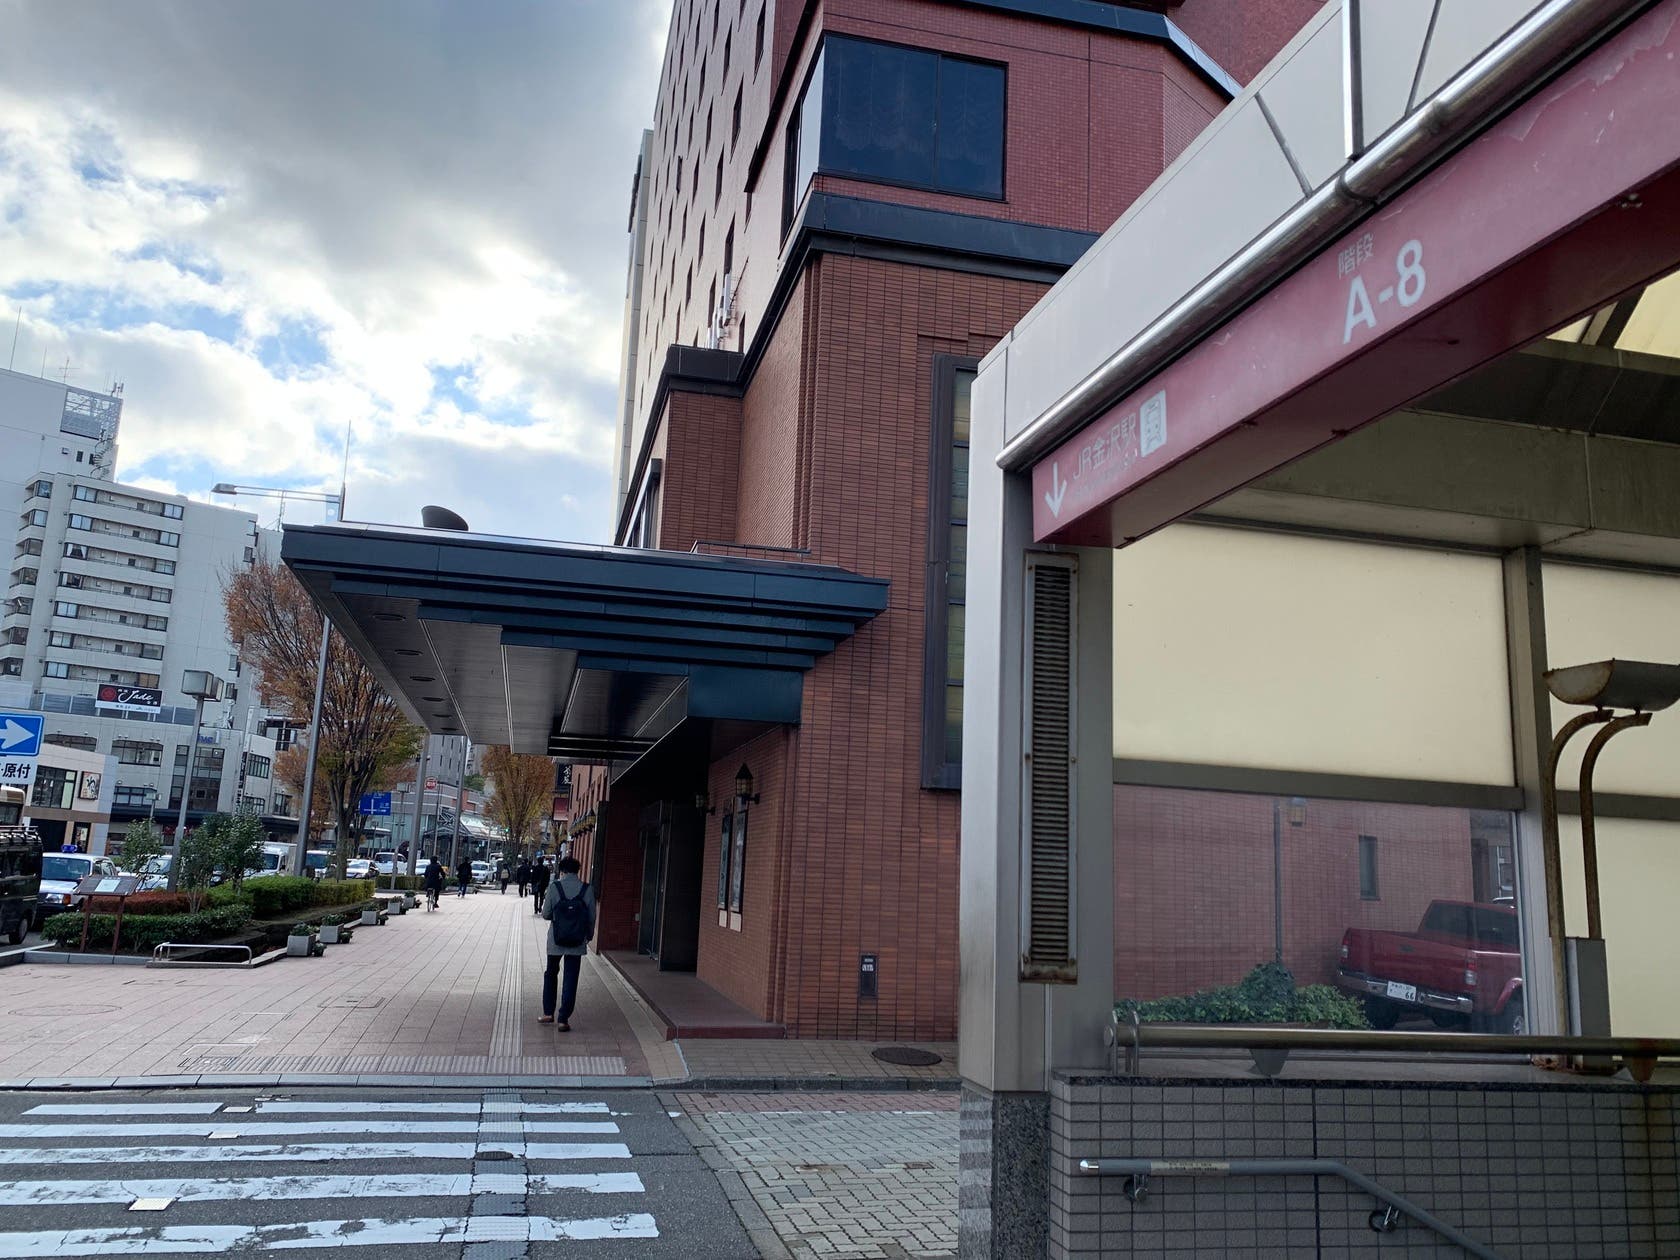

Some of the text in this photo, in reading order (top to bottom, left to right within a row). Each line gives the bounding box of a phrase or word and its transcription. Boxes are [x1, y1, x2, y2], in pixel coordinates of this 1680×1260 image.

[1338, 232, 1374, 280] 階段
[1343, 239, 1426, 345] A-8
[1073, 412, 1137, 480] JR金沢駅
